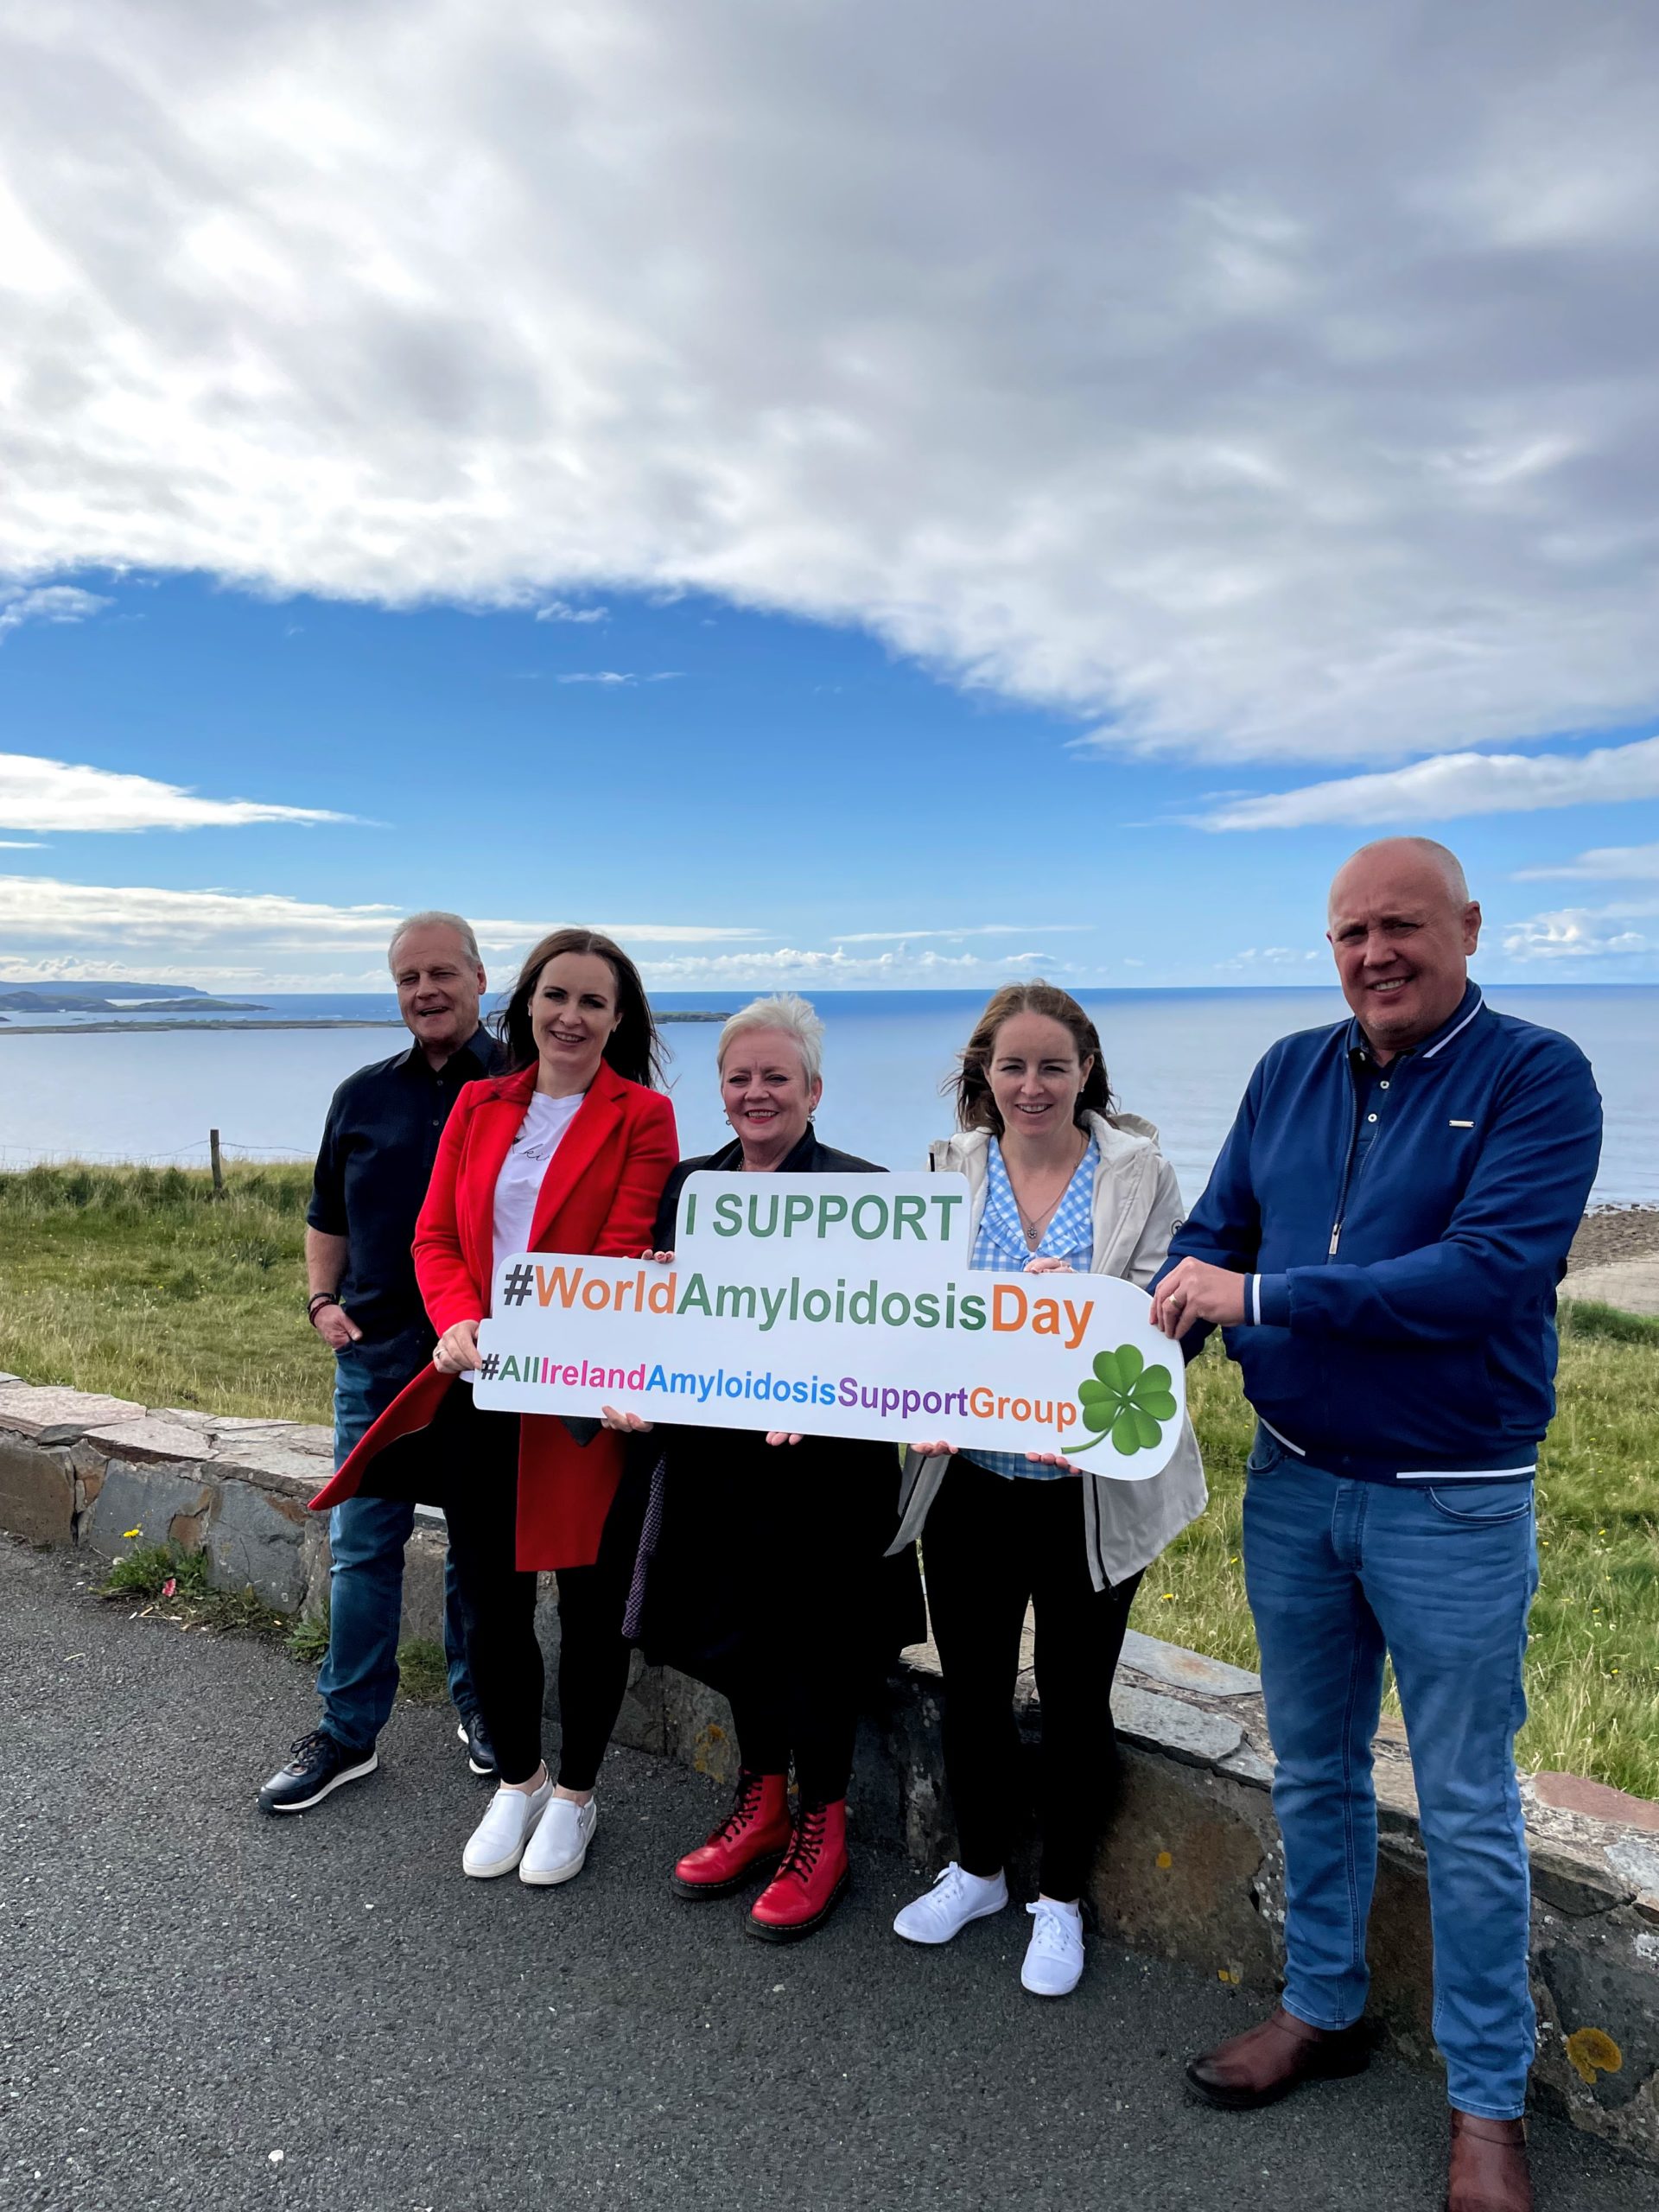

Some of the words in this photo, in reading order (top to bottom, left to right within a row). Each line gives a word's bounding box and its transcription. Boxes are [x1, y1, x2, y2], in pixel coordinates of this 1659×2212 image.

[685, 1193, 697, 1236] I
[712, 1193, 963, 1242] SUPPORT
[503, 1263, 1095, 1350] #WorldAmyloidosisDay
[480, 1353, 1077, 1433] #AllIrelandAmyloidosisSupportGroup
